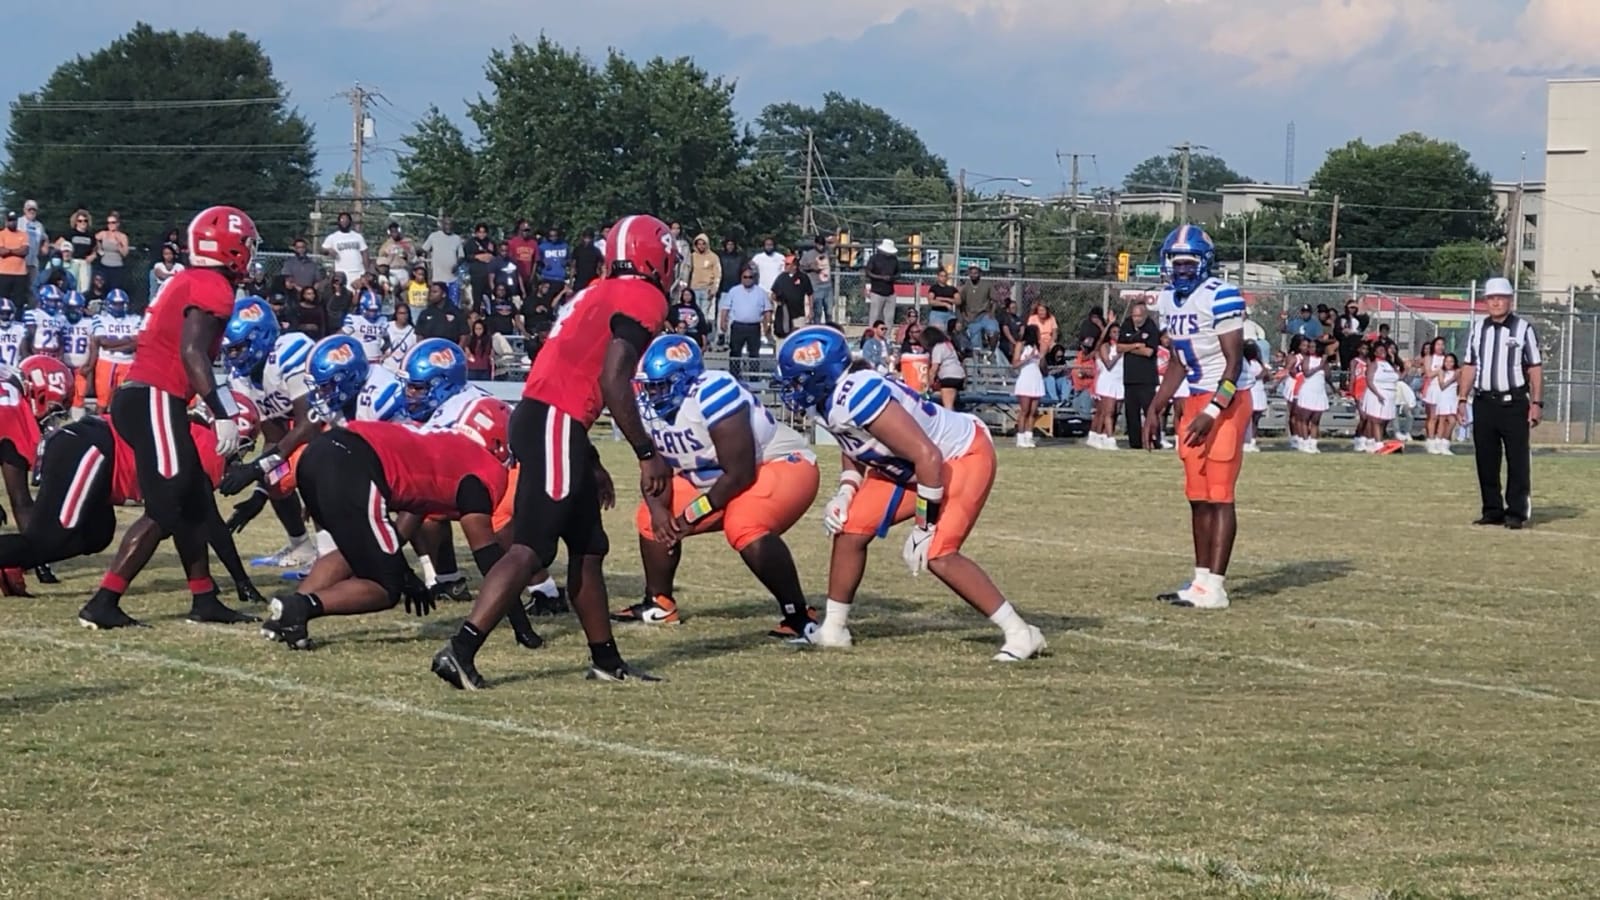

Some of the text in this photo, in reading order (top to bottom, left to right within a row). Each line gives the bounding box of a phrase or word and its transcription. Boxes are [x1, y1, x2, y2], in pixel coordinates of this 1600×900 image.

[228, 214, 243, 233] 2
[661, 233, 673, 254] 4
[108, 324, 132, 334] CATS
[836, 380, 855, 407] 50
[651, 427, 704, 454] CATS
